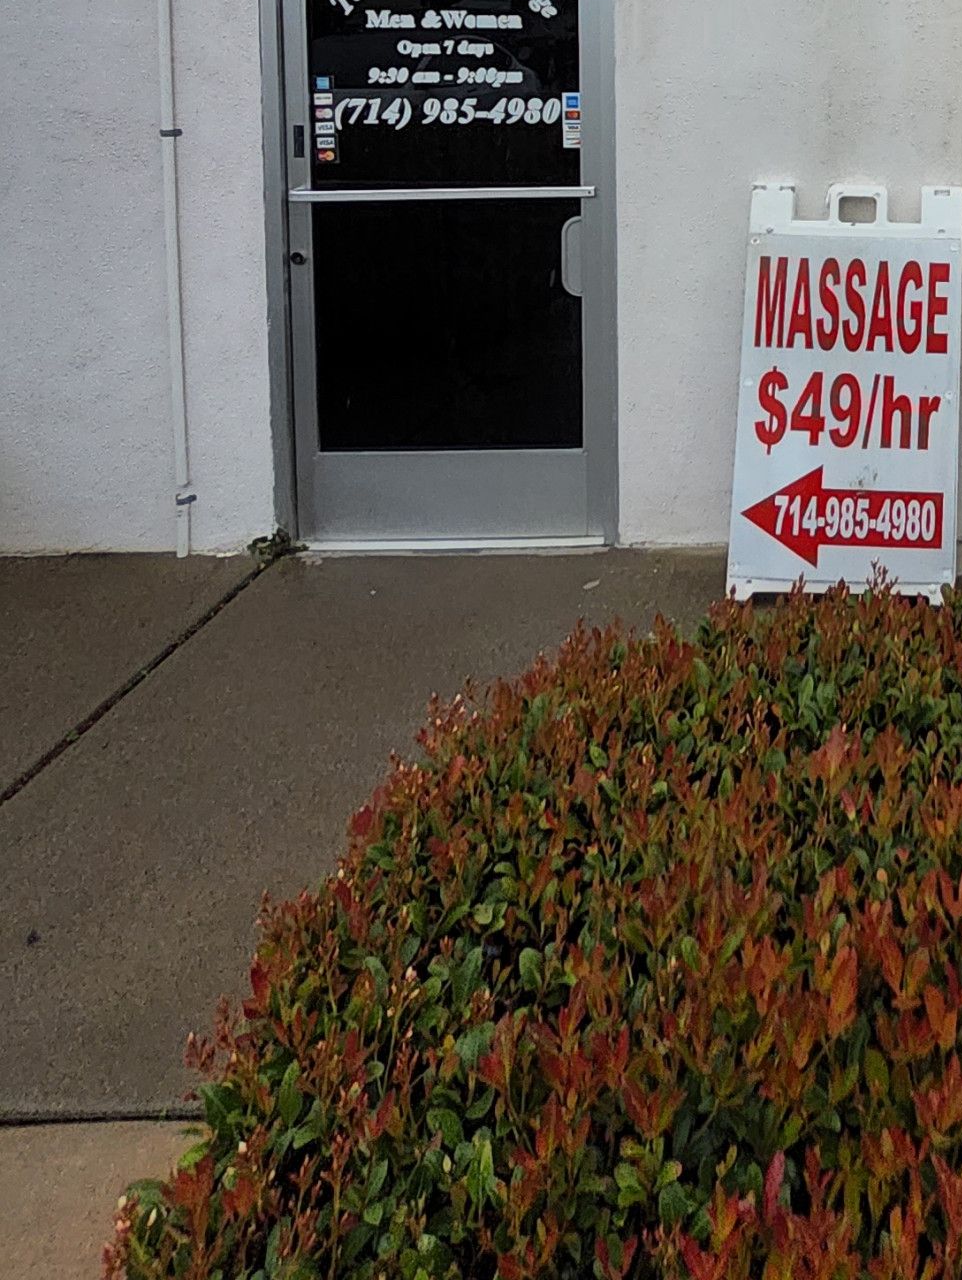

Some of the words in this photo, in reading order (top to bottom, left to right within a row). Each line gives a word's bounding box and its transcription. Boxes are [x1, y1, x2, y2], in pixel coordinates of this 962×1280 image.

[365, 9, 416, 29] Men
[397, 39, 442, 58] Open
[442, 40, 455, 55] 7
[457, 40, 495, 58] days
[367, 67, 410, 84] 9:30
[335, 97, 412, 130] (714)
[421, 97, 562, 124] 985-4980
[754, 256, 950, 354] MASSAGE
[754, 366, 941, 455] $49/hr
[774, 495, 937, 542] 714-985-4980
